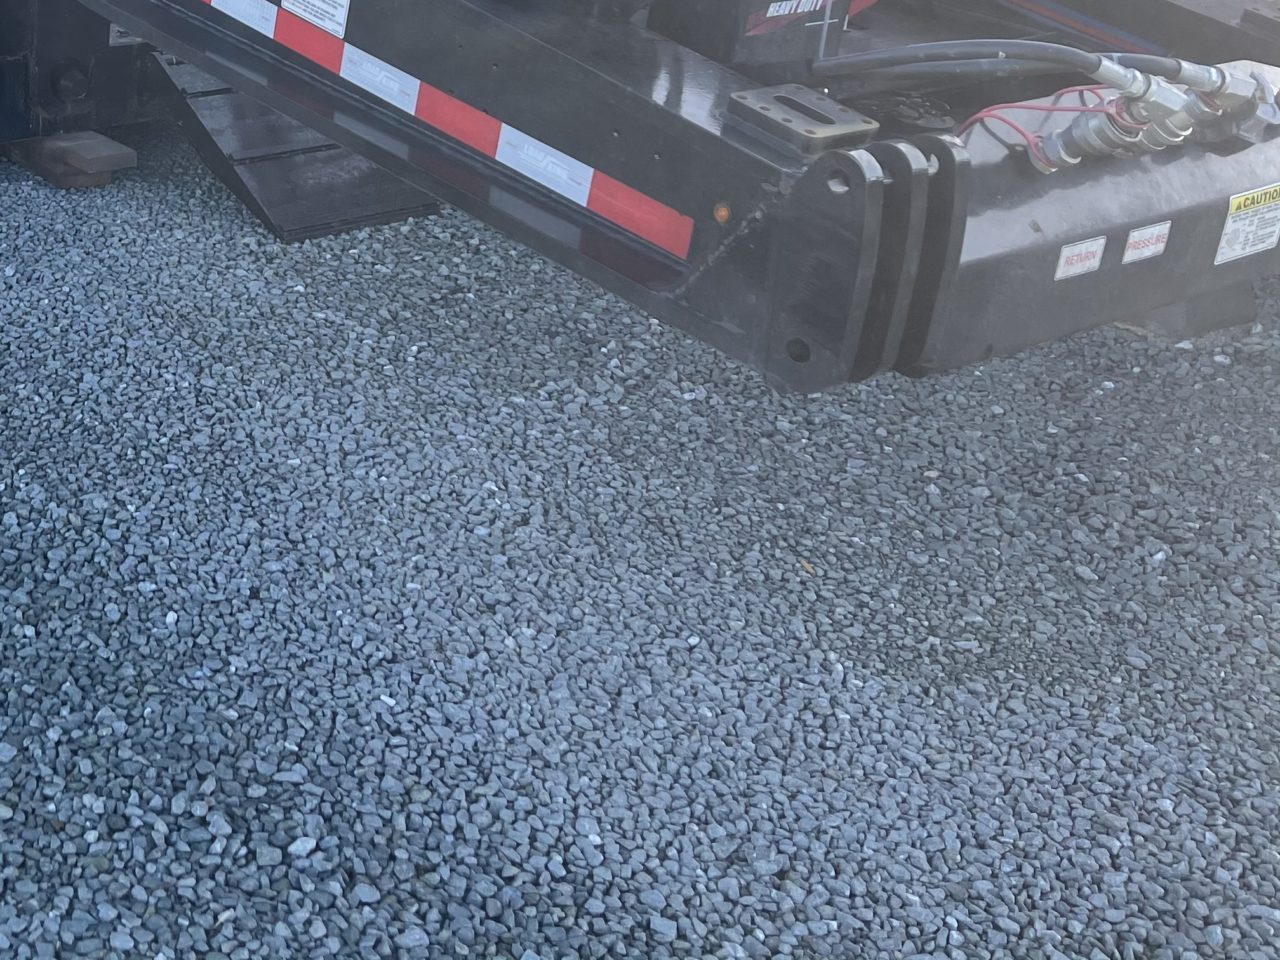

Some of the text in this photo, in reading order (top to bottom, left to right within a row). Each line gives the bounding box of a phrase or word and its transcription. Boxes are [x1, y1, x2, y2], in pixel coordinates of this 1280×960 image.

[766, 0, 800, 17] HEAVY
[1243, 186, 1280, 209] CAUTIO
[1127, 233, 1168, 252] PRESSURE
[1064, 250, 1098, 268] RETURN
